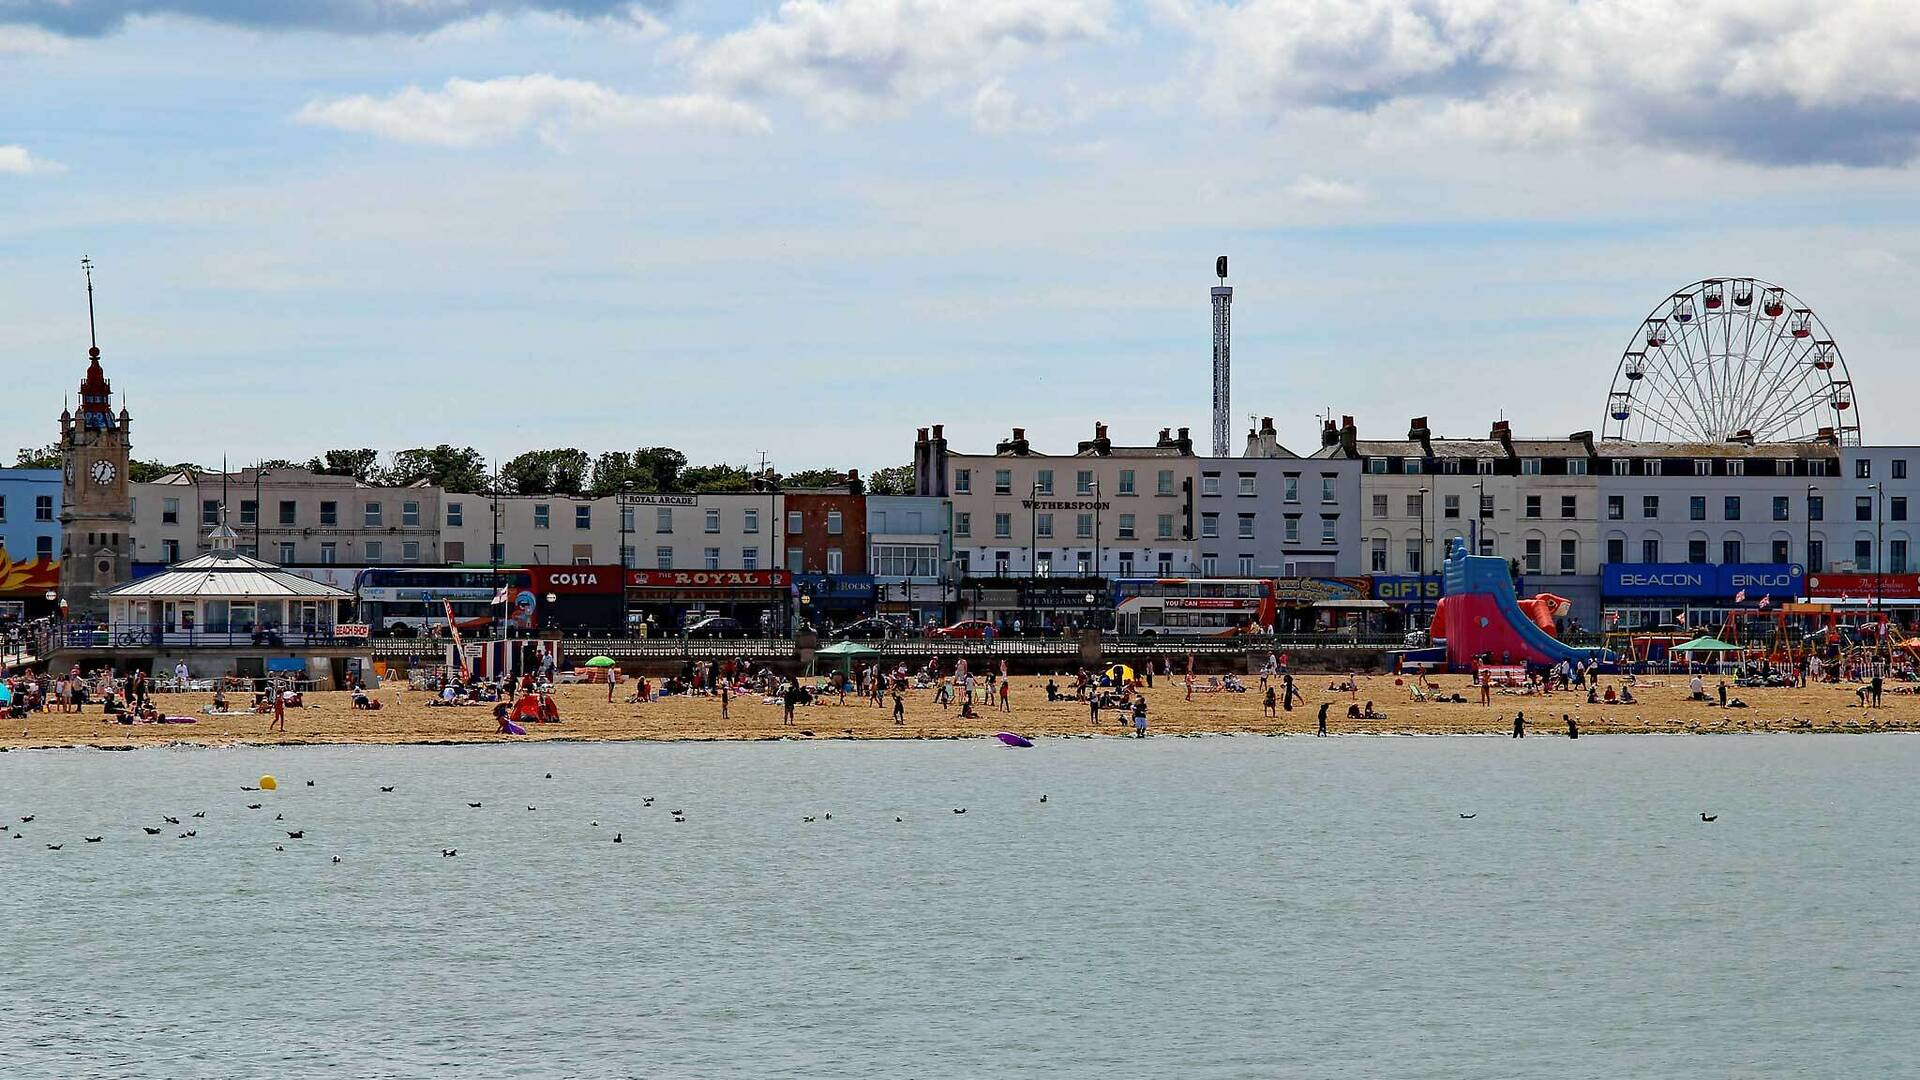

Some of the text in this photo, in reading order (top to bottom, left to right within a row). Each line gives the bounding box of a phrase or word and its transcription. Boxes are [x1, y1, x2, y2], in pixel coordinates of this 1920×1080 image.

[629, 495, 657, 504] ROYAL
[658, 496, 693, 505] ARCADE
[1021, 500, 1110, 510] WETHERSPOON
[549, 573, 598, 586] COSTA
[674, 572, 759, 584] ROYAL
[1620, 574, 1791, 586] BEACON BINGO
[1379, 582, 1439, 598] GIFTS
[336, 625, 353, 636] BEACH
